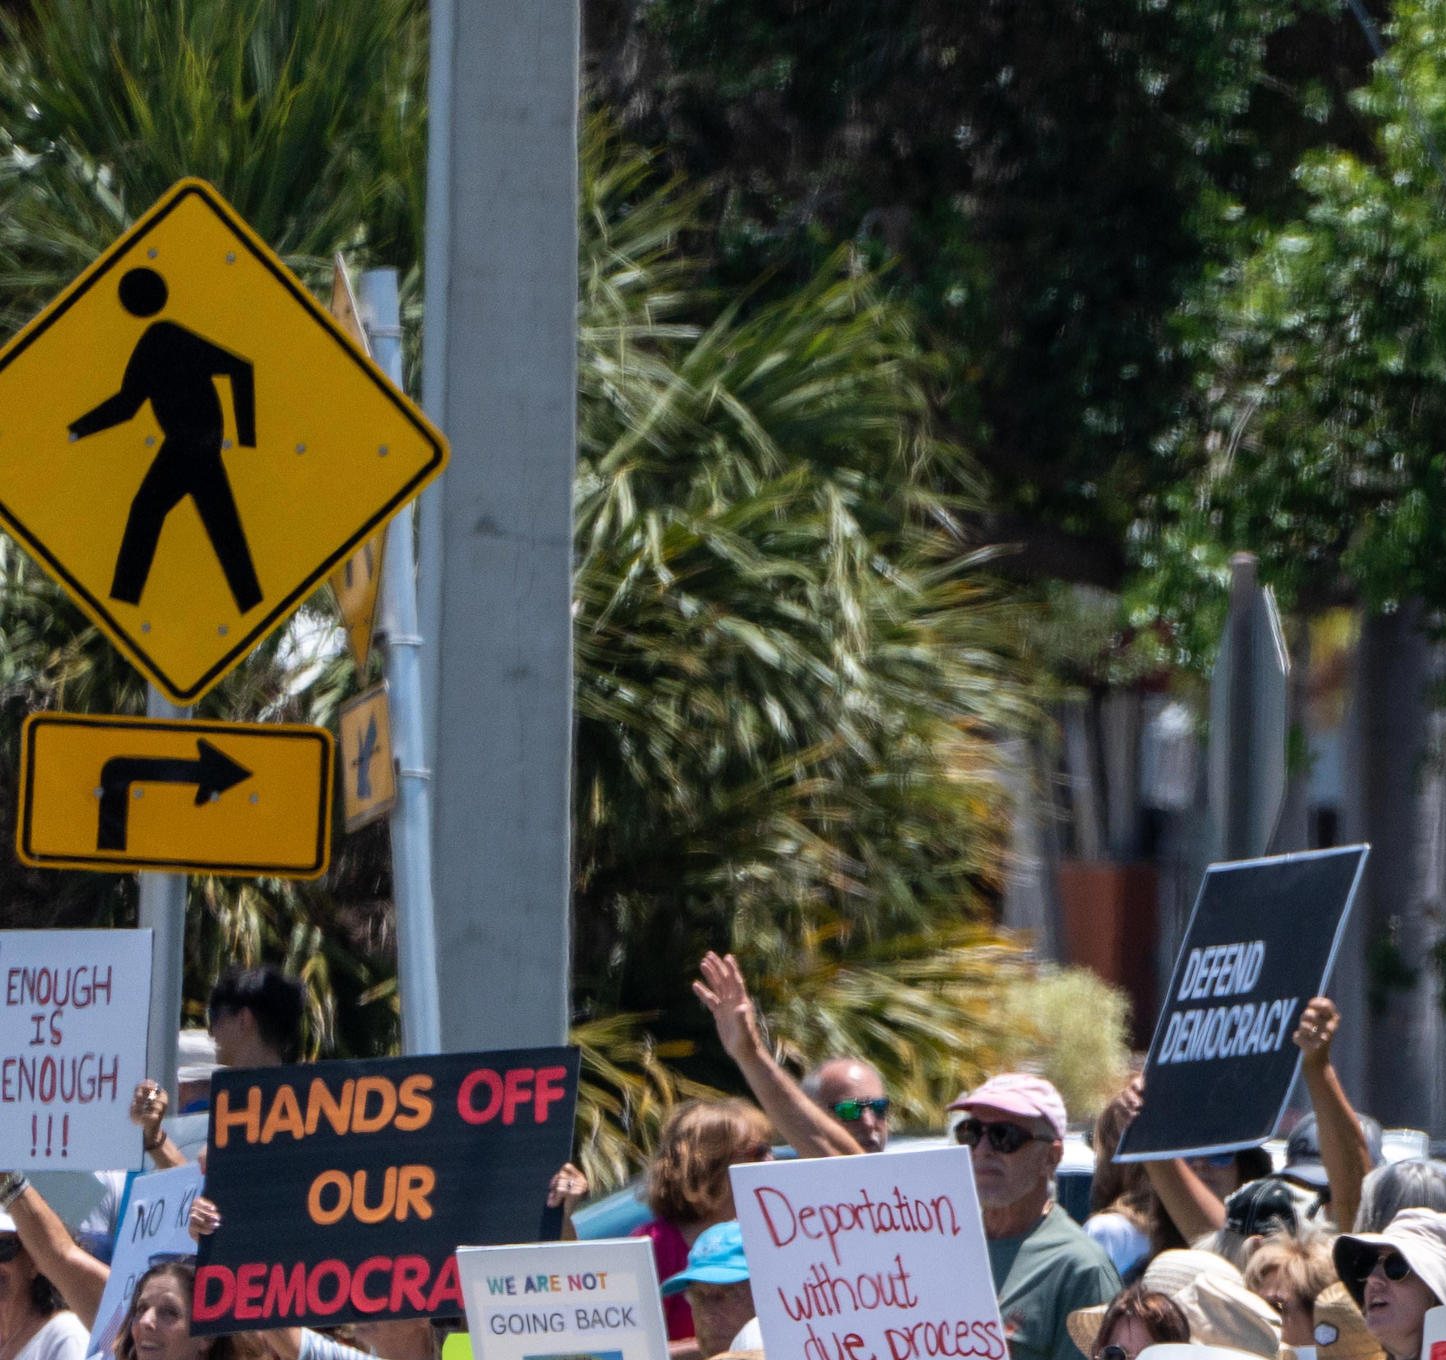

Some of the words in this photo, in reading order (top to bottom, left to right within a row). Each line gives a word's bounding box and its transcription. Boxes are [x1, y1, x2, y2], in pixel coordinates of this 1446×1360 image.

[6, 965, 113, 1010] ENOUGH
[1177, 940, 1265, 1000] DEFEND
[28, 1009, 63, 1047] IS
[1157, 997, 1299, 1065] DEMOCRACY
[0, 1053, 119, 1105] ENOUGH
[214, 1074, 435, 1149] HANDS
[455, 1065, 569, 1127] OFF
[132, 1198, 166, 1244] NO
[306, 1163, 436, 1227] OUR
[754, 1186, 960, 1265] Deportation
[192, 1255, 465, 1323] DEMOCRA
[486, 1276, 517, 1296] WE
[524, 1274, 562, 1295] ARE
[567, 1272, 608, 1292] NOT
[778, 1254, 918, 1323] without
[490, 1312, 565, 1335] GOING
[575, 1307, 636, 1330] BACK
